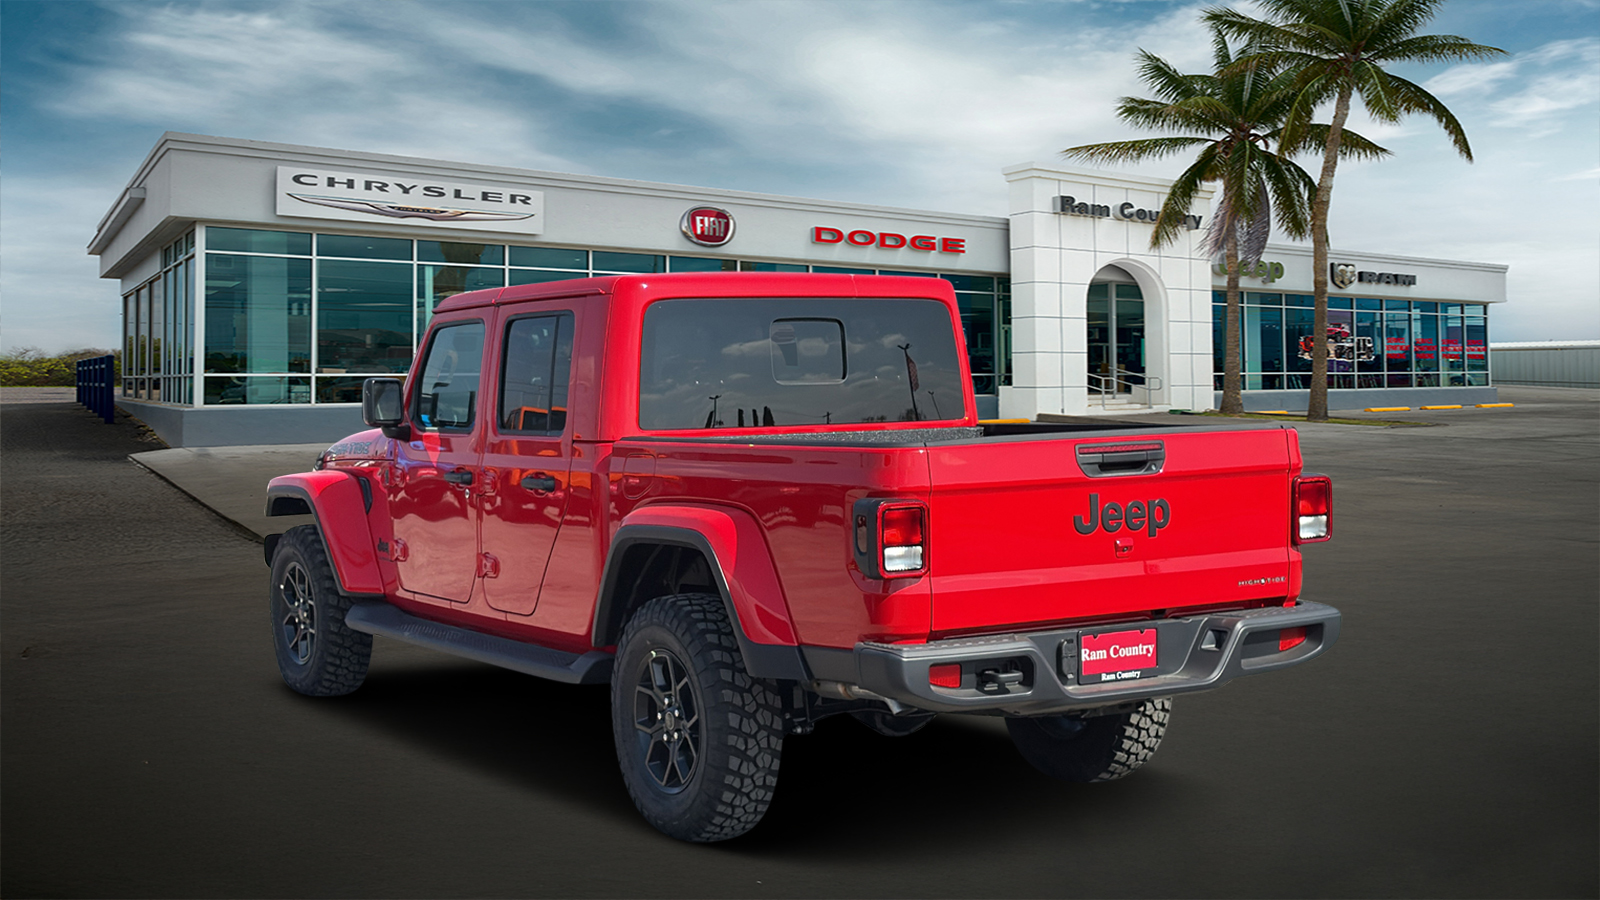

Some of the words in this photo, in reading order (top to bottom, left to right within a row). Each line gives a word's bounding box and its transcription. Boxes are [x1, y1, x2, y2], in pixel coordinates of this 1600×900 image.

[292, 173, 532, 206] CHRYSLER
[1054, 195, 1110, 218] Ram
[1114, 201, 1203, 231] Coury
[695, 216, 728, 237] FIAT
[811, 226, 966, 254] DODGE
[1357, 271, 1417, 286] RAM
[1073, 493, 1170, 538] Jeep
[1081, 648, 1107, 662] Ram
[1109, 643, 1155, 658] Country
[1101, 672, 1116, 681] Ram
[1116, 670, 1141, 679] Country
